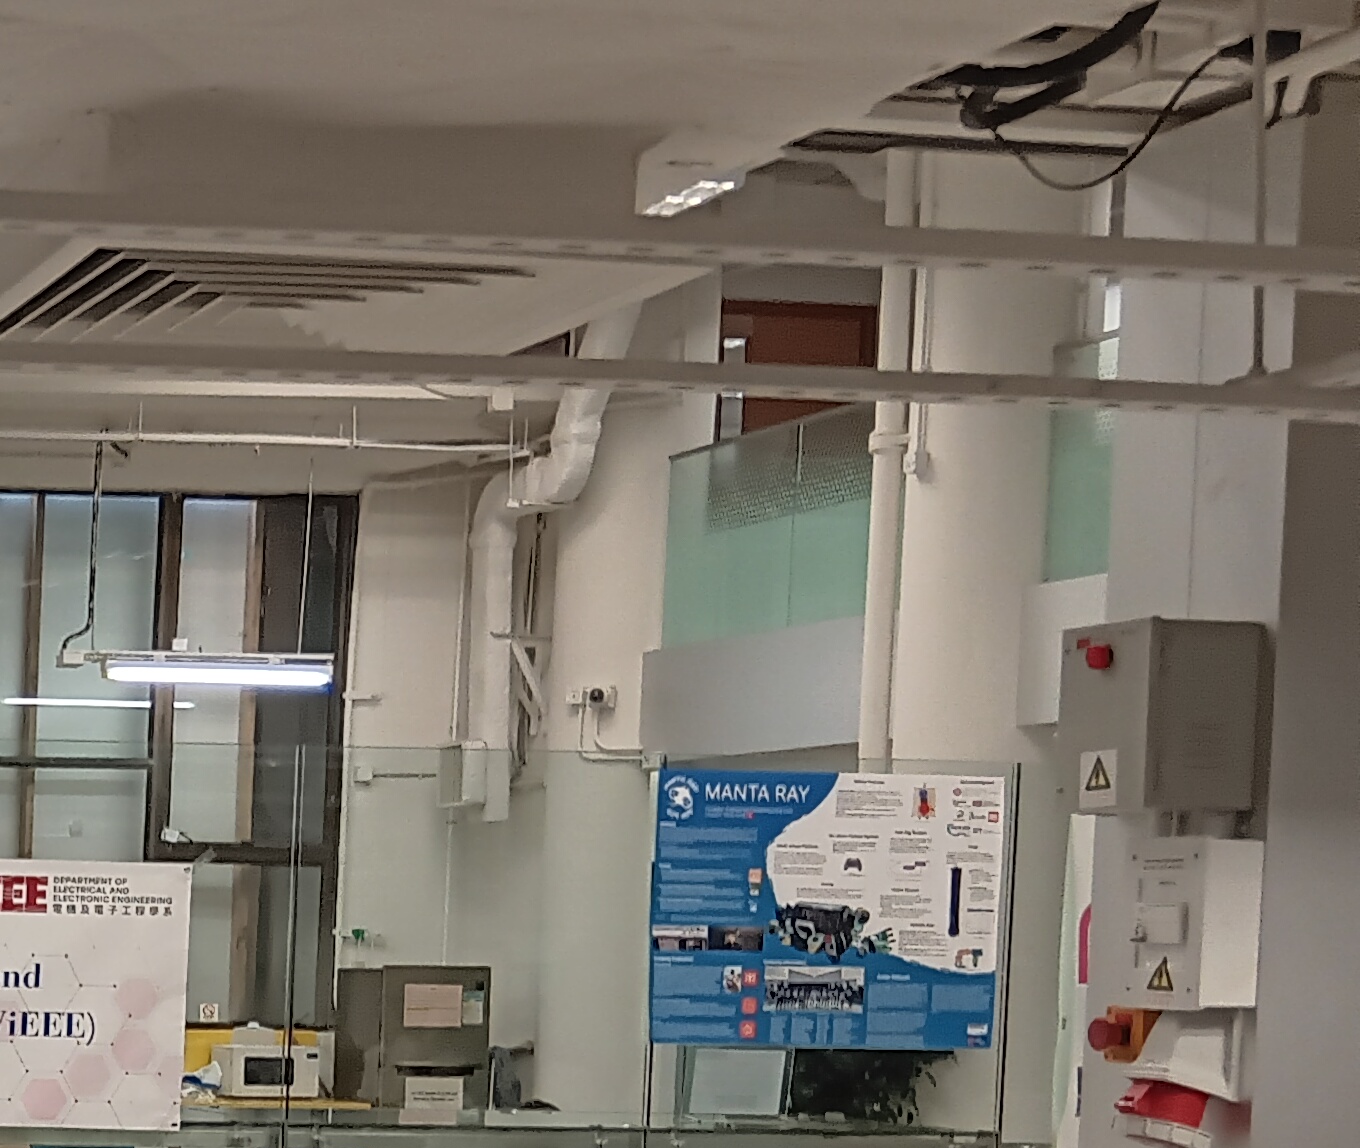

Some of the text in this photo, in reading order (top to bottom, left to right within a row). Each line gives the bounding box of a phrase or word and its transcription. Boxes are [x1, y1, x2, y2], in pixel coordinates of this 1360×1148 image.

[705, 782, 770, 803] MANTA
[775, 784, 811, 804] RAY
[53, 876, 128, 886] DEPARTMENT OF
[53, 885, 130, 895] ELECTRICAL AND
[53, 894, 173, 905] ELECTRONIC ENGINEERING
